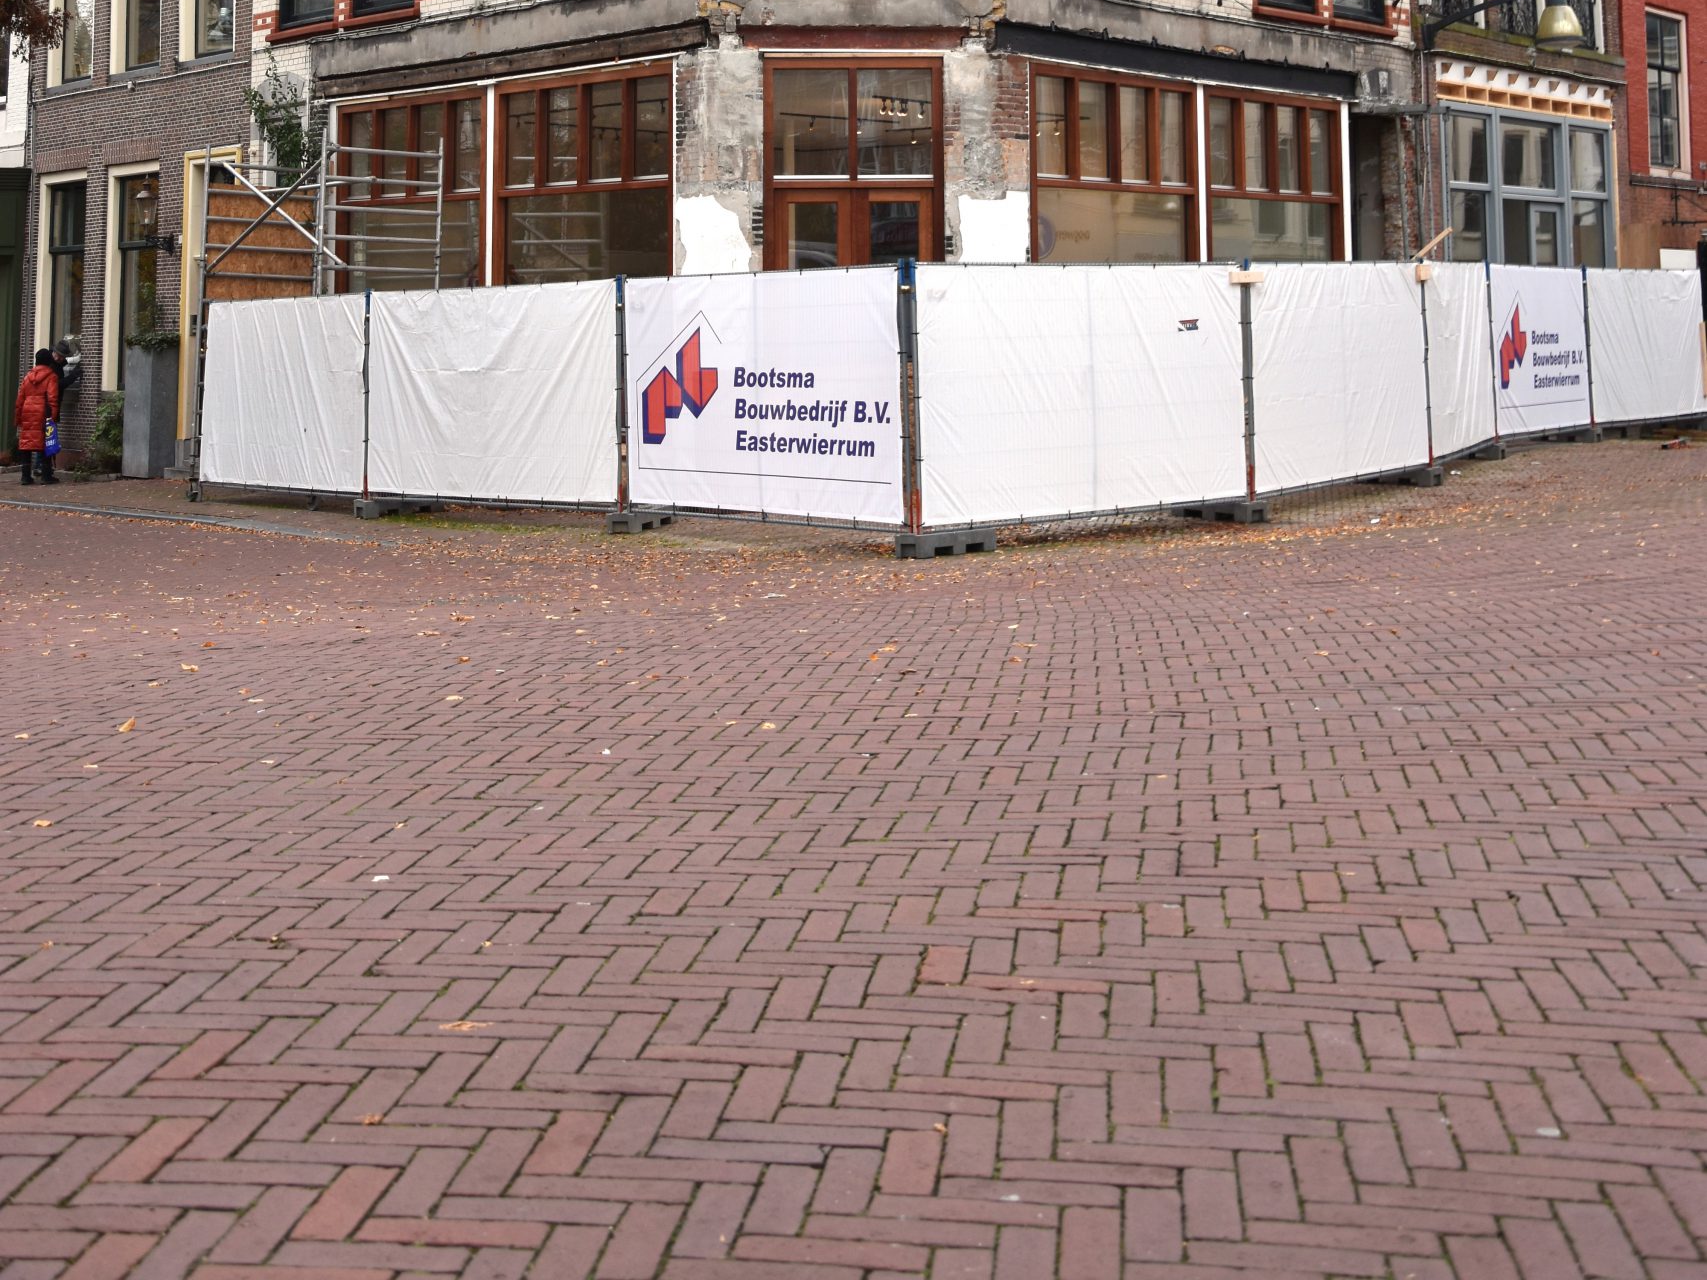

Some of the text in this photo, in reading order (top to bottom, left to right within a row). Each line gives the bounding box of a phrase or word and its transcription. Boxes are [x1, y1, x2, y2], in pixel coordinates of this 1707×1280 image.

[1531, 331, 1559, 345] Bootsma
[1532, 350, 1584, 368] Bouwbedrijf B.V.
[733, 366, 815, 388] Bootsma
[1533, 373, 1580, 389] Easterwierrum
[734, 398, 891, 428] Bouwbedrijf B.V.
[735, 430, 875, 458] Easterwierrum
